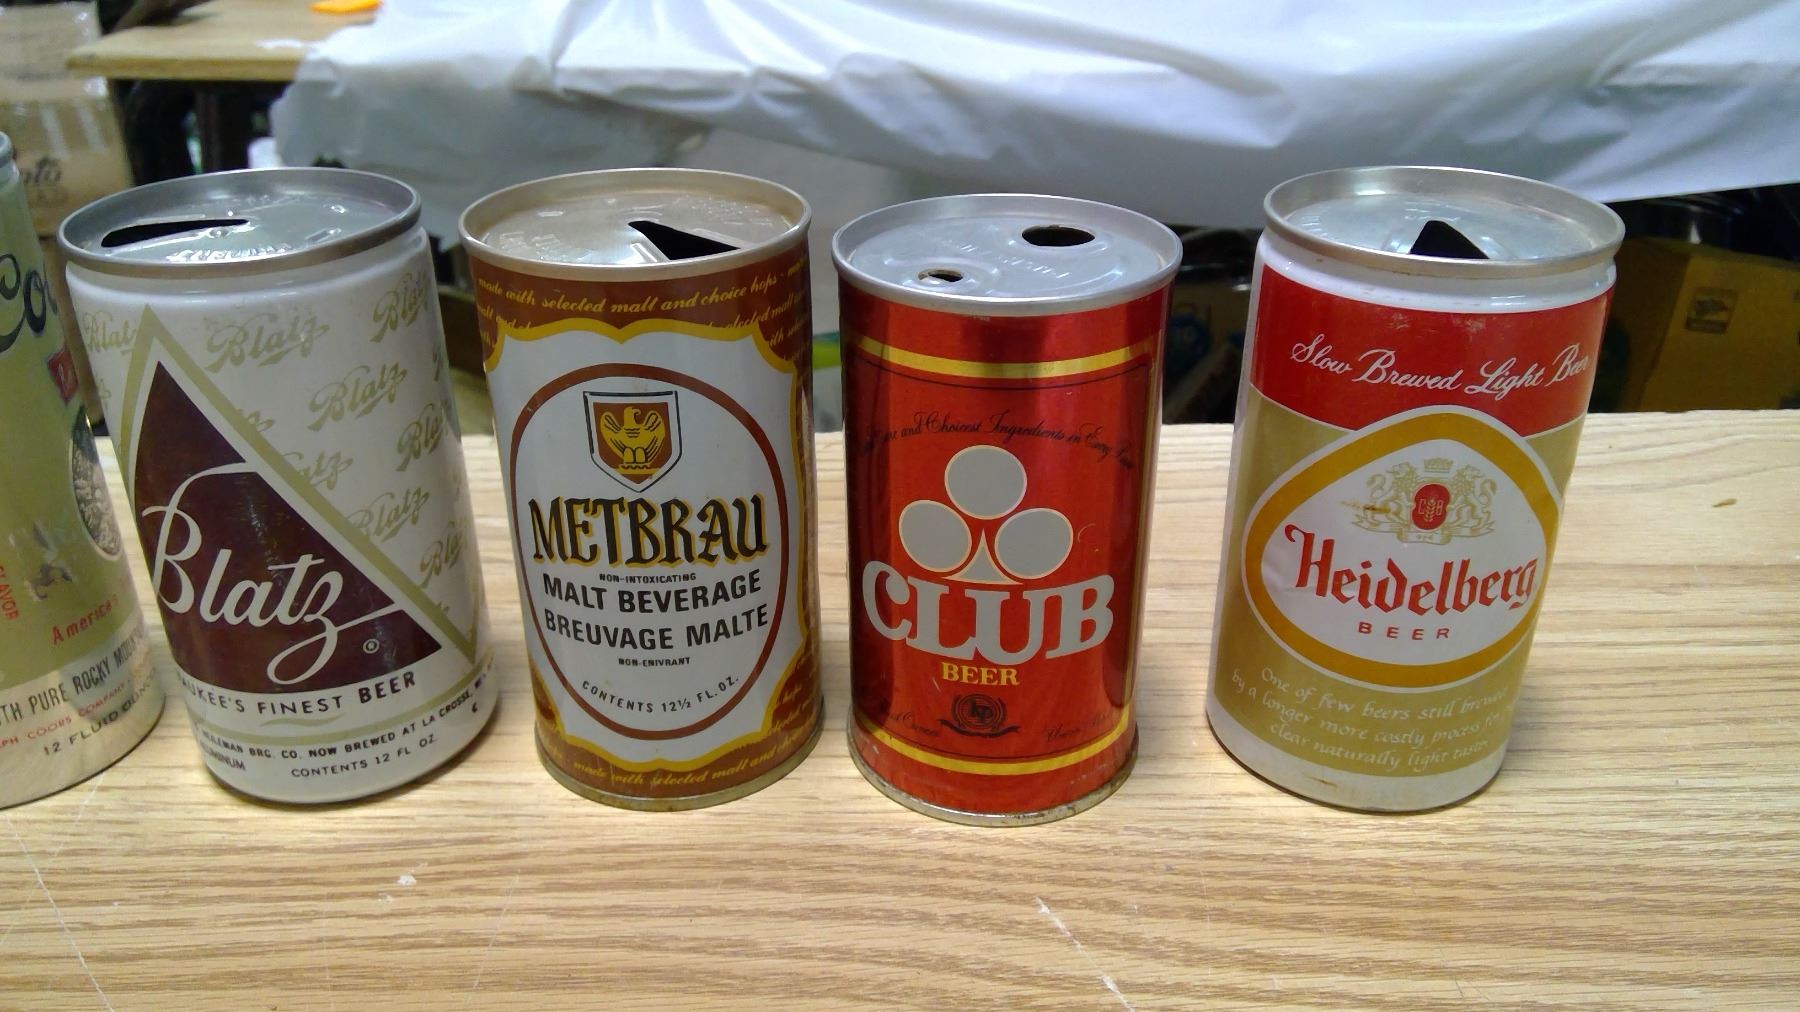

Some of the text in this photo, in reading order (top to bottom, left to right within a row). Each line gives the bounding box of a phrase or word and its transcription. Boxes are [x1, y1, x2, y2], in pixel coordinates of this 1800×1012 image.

[478, 274, 777, 313] made with selected malt and choice hops
[1290, 333, 1353, 375] Slow
[1352, 348, 1464, 391] Brewed
[1464, 357, 1545, 400] Light
[308, 363, 407, 431] Blatz
[988, 409, 1065, 444] Ingredients
[527, 492, 771, 568] METBRAU
[142, 462, 398, 685] Blatz
[542, 568, 761, 614] MALT BEVERAGE
[599, 573, 697, 584] NON-INTOXICATING
[1284, 523, 1539, 617] Heidelberg
[543, 603, 769, 651] BREUVAGE MALTE
[862, 560, 1115, 666] CLUB
[1357, 621, 1450, 641] BEER
[618, 657, 691, 667] NON-ENIVRANT
[941, 662, 1021, 686] BEER
[28, 683, 69, 716] PURE
[71, 658, 111, 695] ROCKY
[256, 695, 343, 715] FINEST
[358, 671, 416, 704] BEER
[582, 680, 654, 713] CONTENTS
[1232, 668, 1246, 693] by
[1262, 690, 1313, 723] longer
[1319, 719, 1369, 740] more
[1375, 728, 1425, 749] costly
[1261, 667, 1290, 693] One
[1295, 687, 1318, 704] of
[1311, 692, 1356, 712] few
[1362, 700, 1411, 719] beers
[1417, 698, 1457, 719] still
[43, 740, 62, 756] 12
[68, 709, 119, 745] FLUID
[308, 746, 338, 758] NOW
[344, 732, 396, 754] BREWED
[402, 722, 416, 737] AT
[422, 715, 436, 728] LA
[1271, 722, 1310, 746] clear
[1313, 741, 1401, 772] naturally
[1407, 750, 1449, 773] light
[291, 760, 369, 779] CONTENTS
[375, 752, 391, 766] 12
[711, 758, 749, 778] malt
